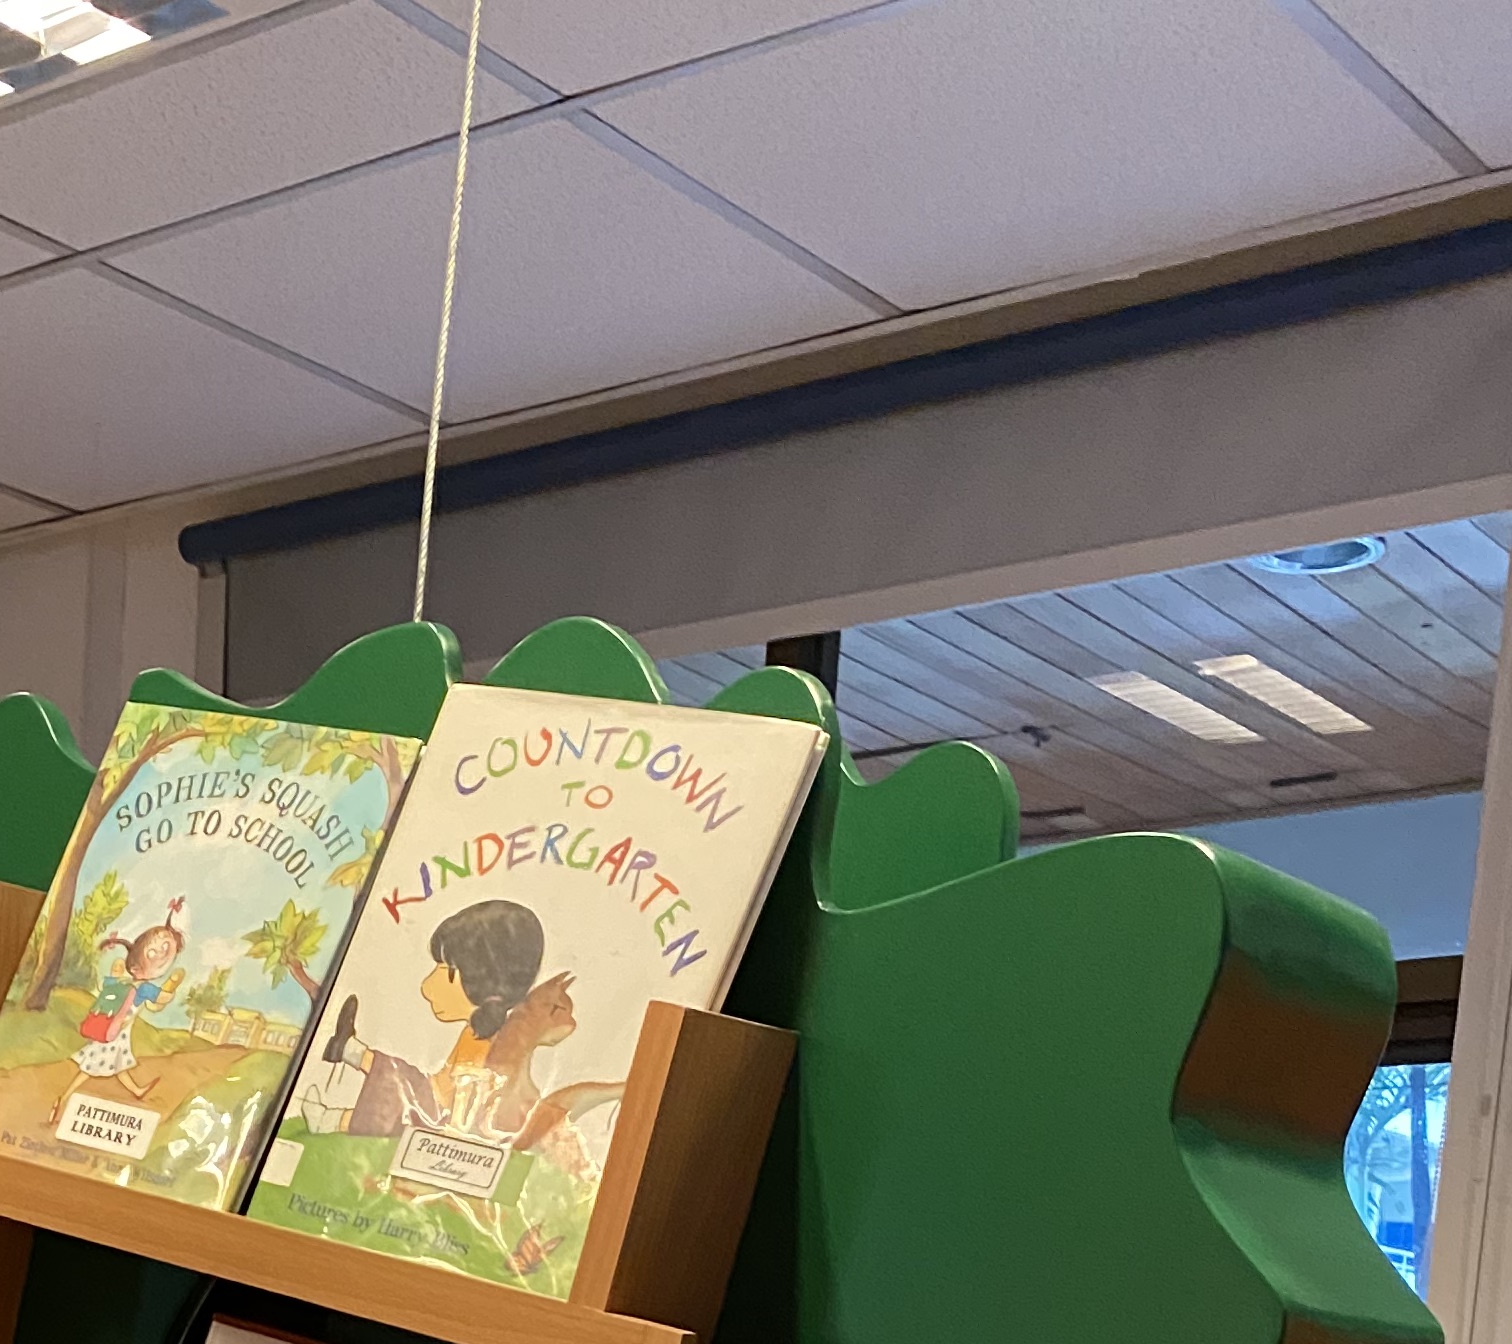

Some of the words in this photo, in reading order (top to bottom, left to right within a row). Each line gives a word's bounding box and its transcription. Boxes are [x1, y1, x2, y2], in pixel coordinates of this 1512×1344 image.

[454, 718, 744, 833] COUNTDOWN
[560, 781, 614, 810] TO
[116, 769, 256, 833] SOPHIE'S
[260, 777, 355, 863] SQUASH
[135, 823, 173, 854] GO
[186, 809, 222, 837] TO
[228, 814, 318, 889] SCHOOL
[382, 824, 708, 977] KINDERGARTEN
[71, 1120, 137, 1147] LIBRARY
[76, 1103, 143, 1131] PATTIMURA
[417, 1137, 495, 1169] Pattimura
[288, 1192, 354, 1224] Pictures
[353, 1211, 374, 1233] by
[377, 1217, 429, 1244] Harry
